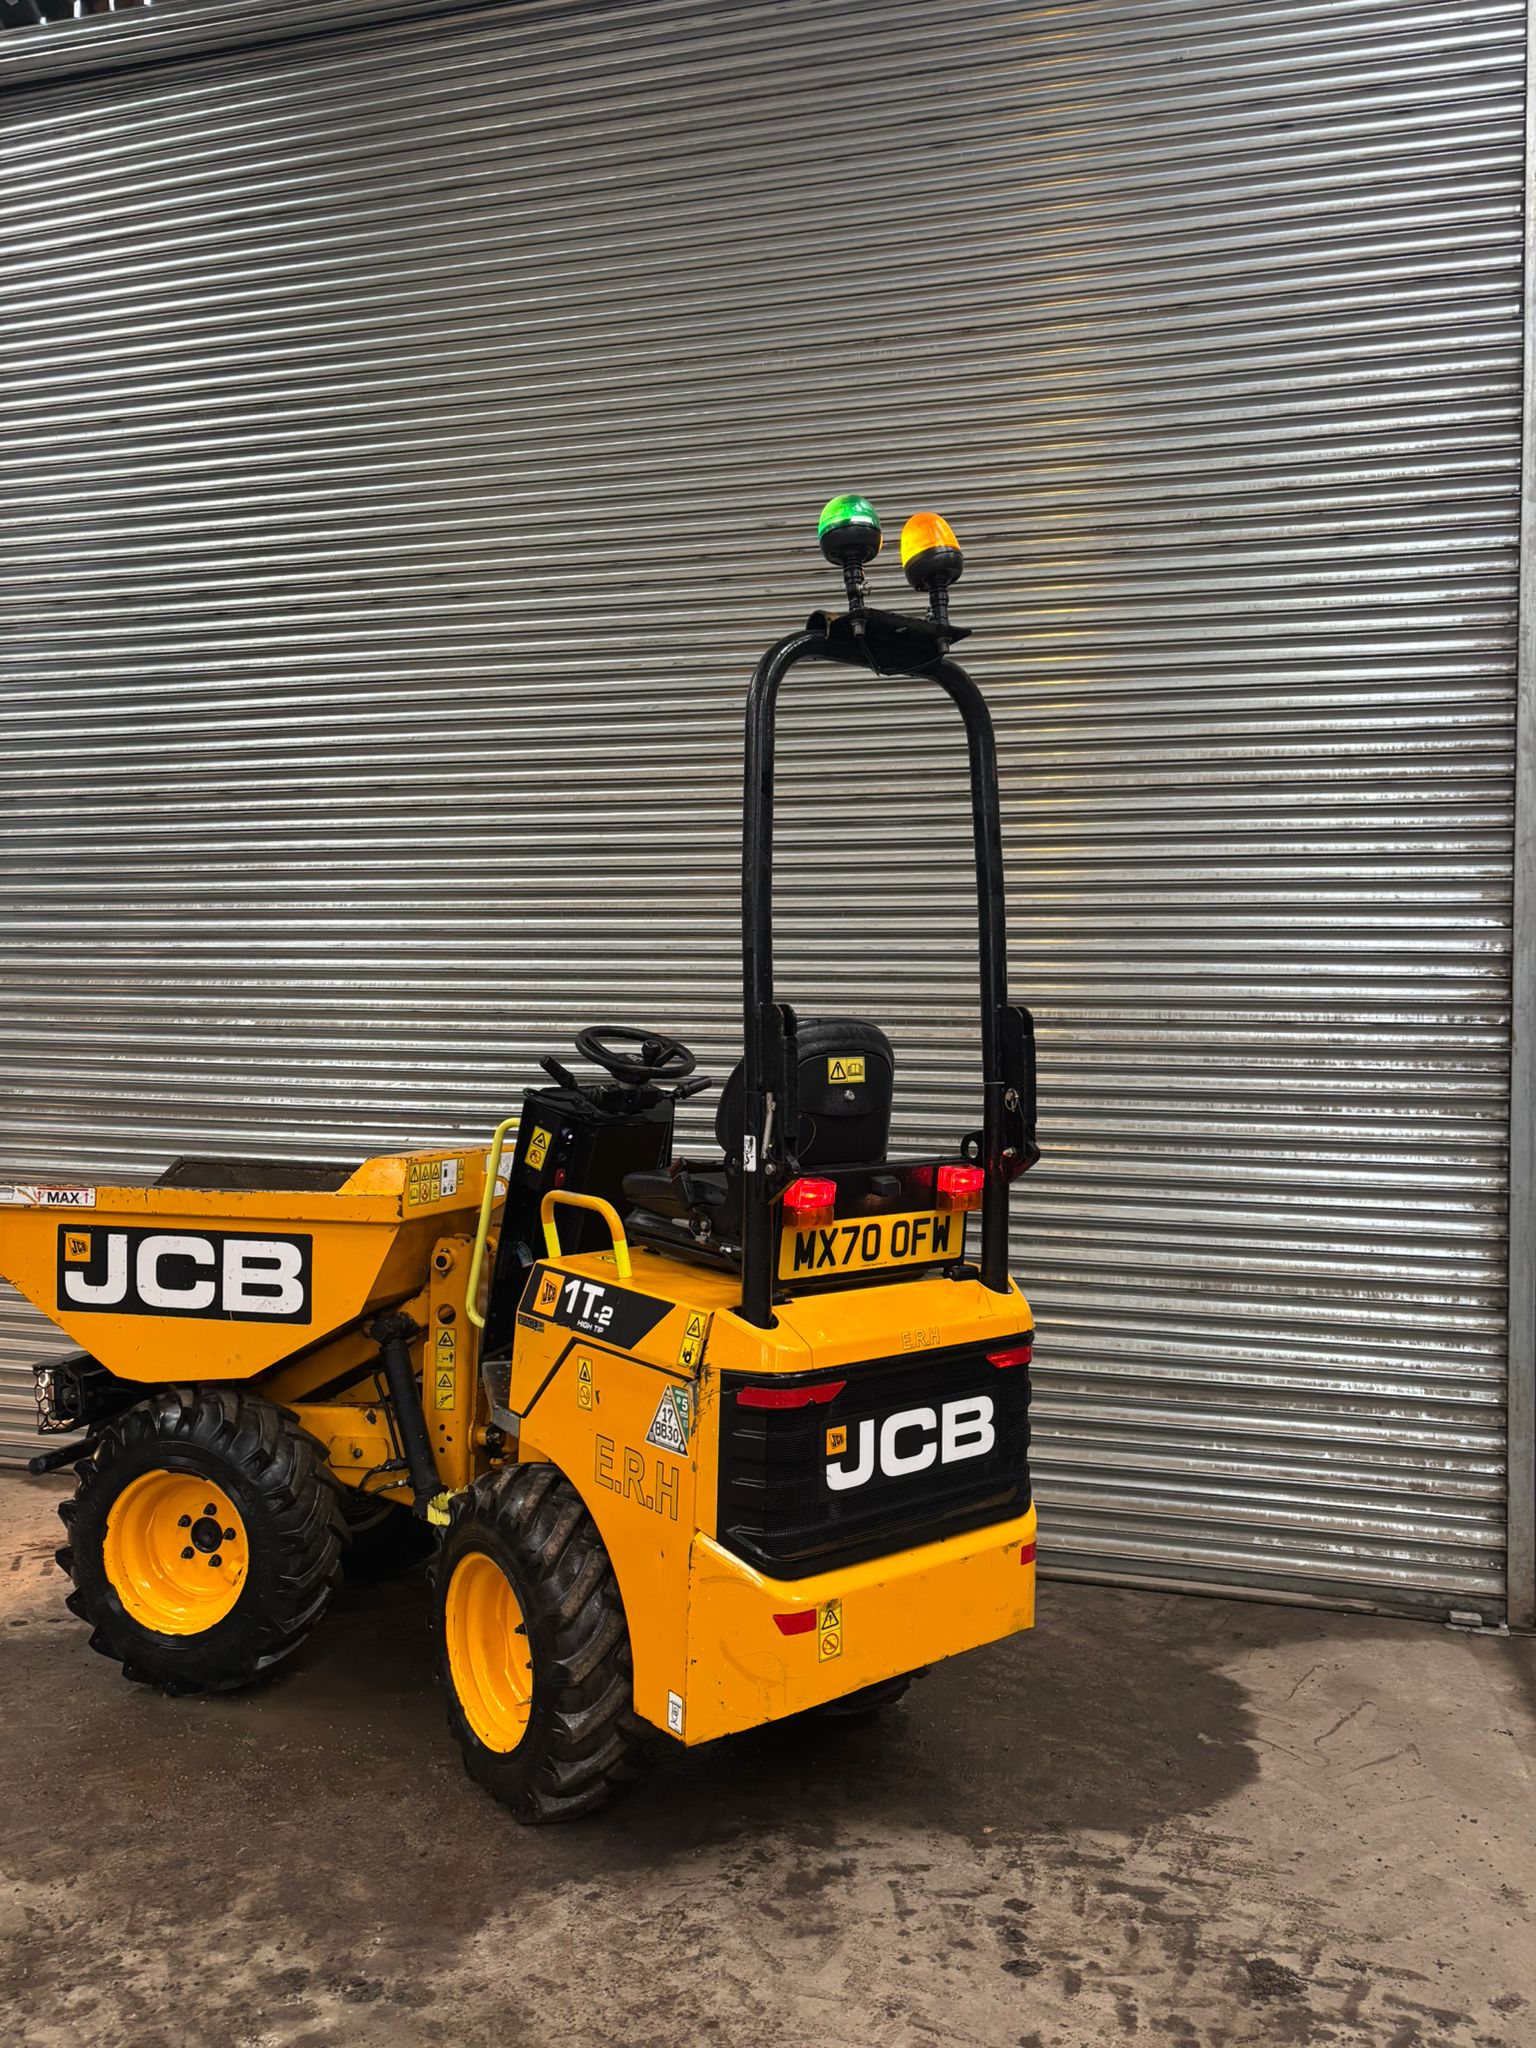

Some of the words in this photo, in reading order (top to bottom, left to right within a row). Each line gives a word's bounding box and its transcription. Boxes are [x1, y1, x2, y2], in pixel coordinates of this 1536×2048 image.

[47, 1191, 80, 1204] MAX
[793, 1223, 881, 1271] MX70
[890, 1215, 951, 1258] OFW
[64, 1233, 304, 1315] JCB
[576, 1319, 593, 1331] HIGH
[594, 1324, 605, 1334] TIP
[901, 1326, 941, 1350] E.R.H
[662, 1407, 674, 1424] 17
[681, 1398, 689, 1412] 5
[826, 1395, 996, 1491] JCB
[594, 1433, 679, 1521] E.R.H
